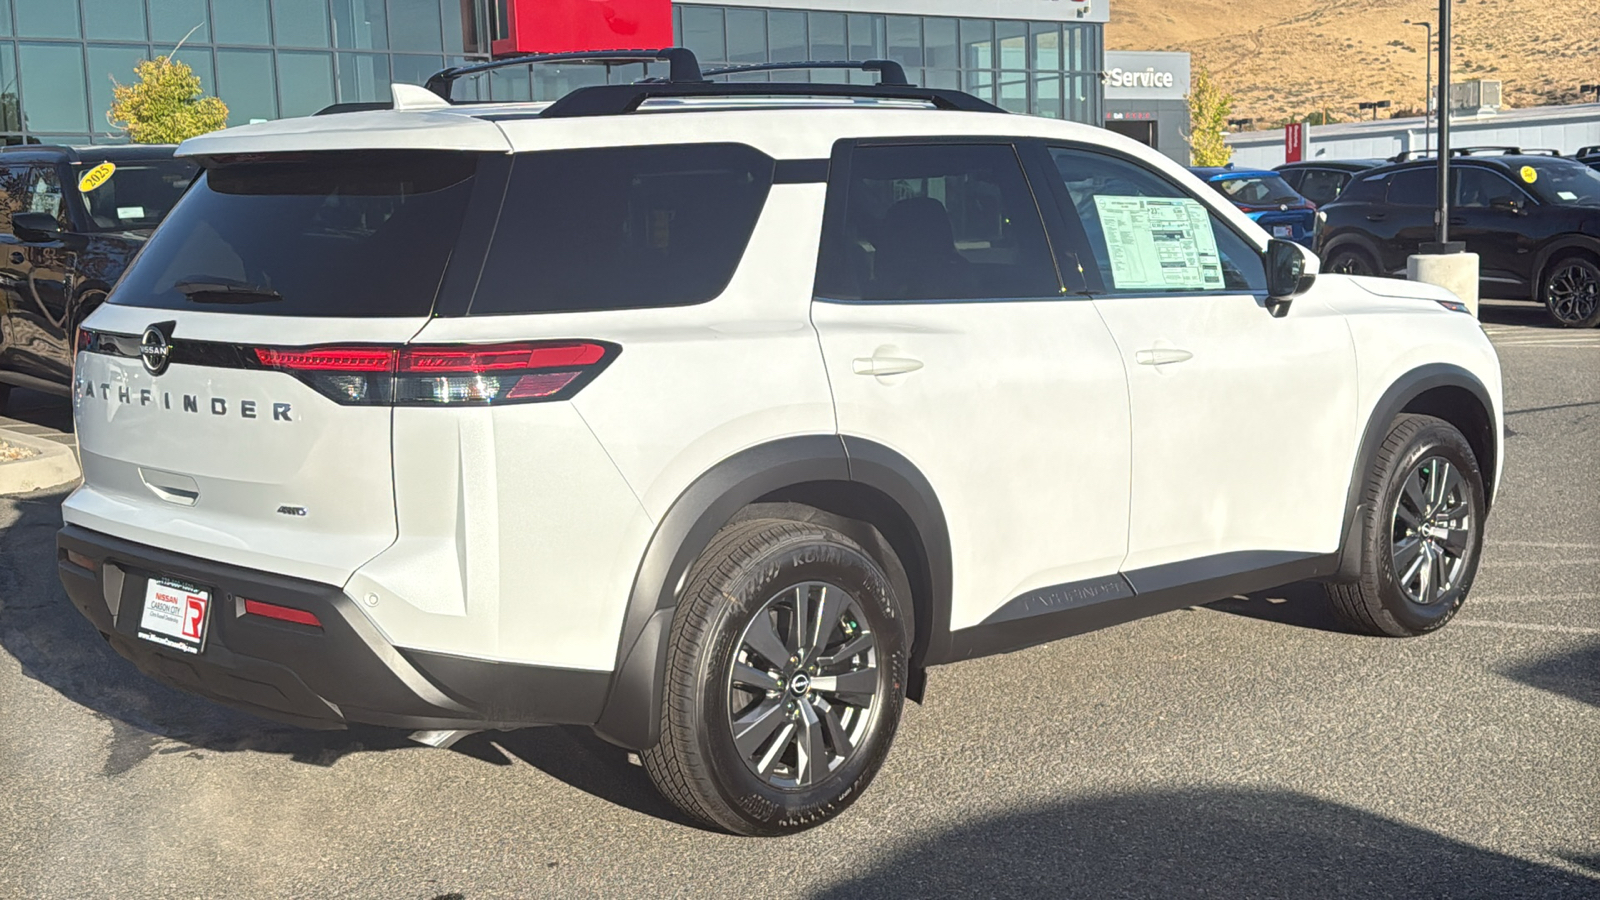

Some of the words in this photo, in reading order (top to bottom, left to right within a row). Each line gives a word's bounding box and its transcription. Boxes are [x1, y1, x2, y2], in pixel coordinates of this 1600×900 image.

[1111, 67, 1174, 88] Service
[85, 165, 110, 187] 2025
[155, 592, 178, 604] NISSAN
[150, 600, 170, 612] CARSON
[170, 606, 181, 614] CITY
